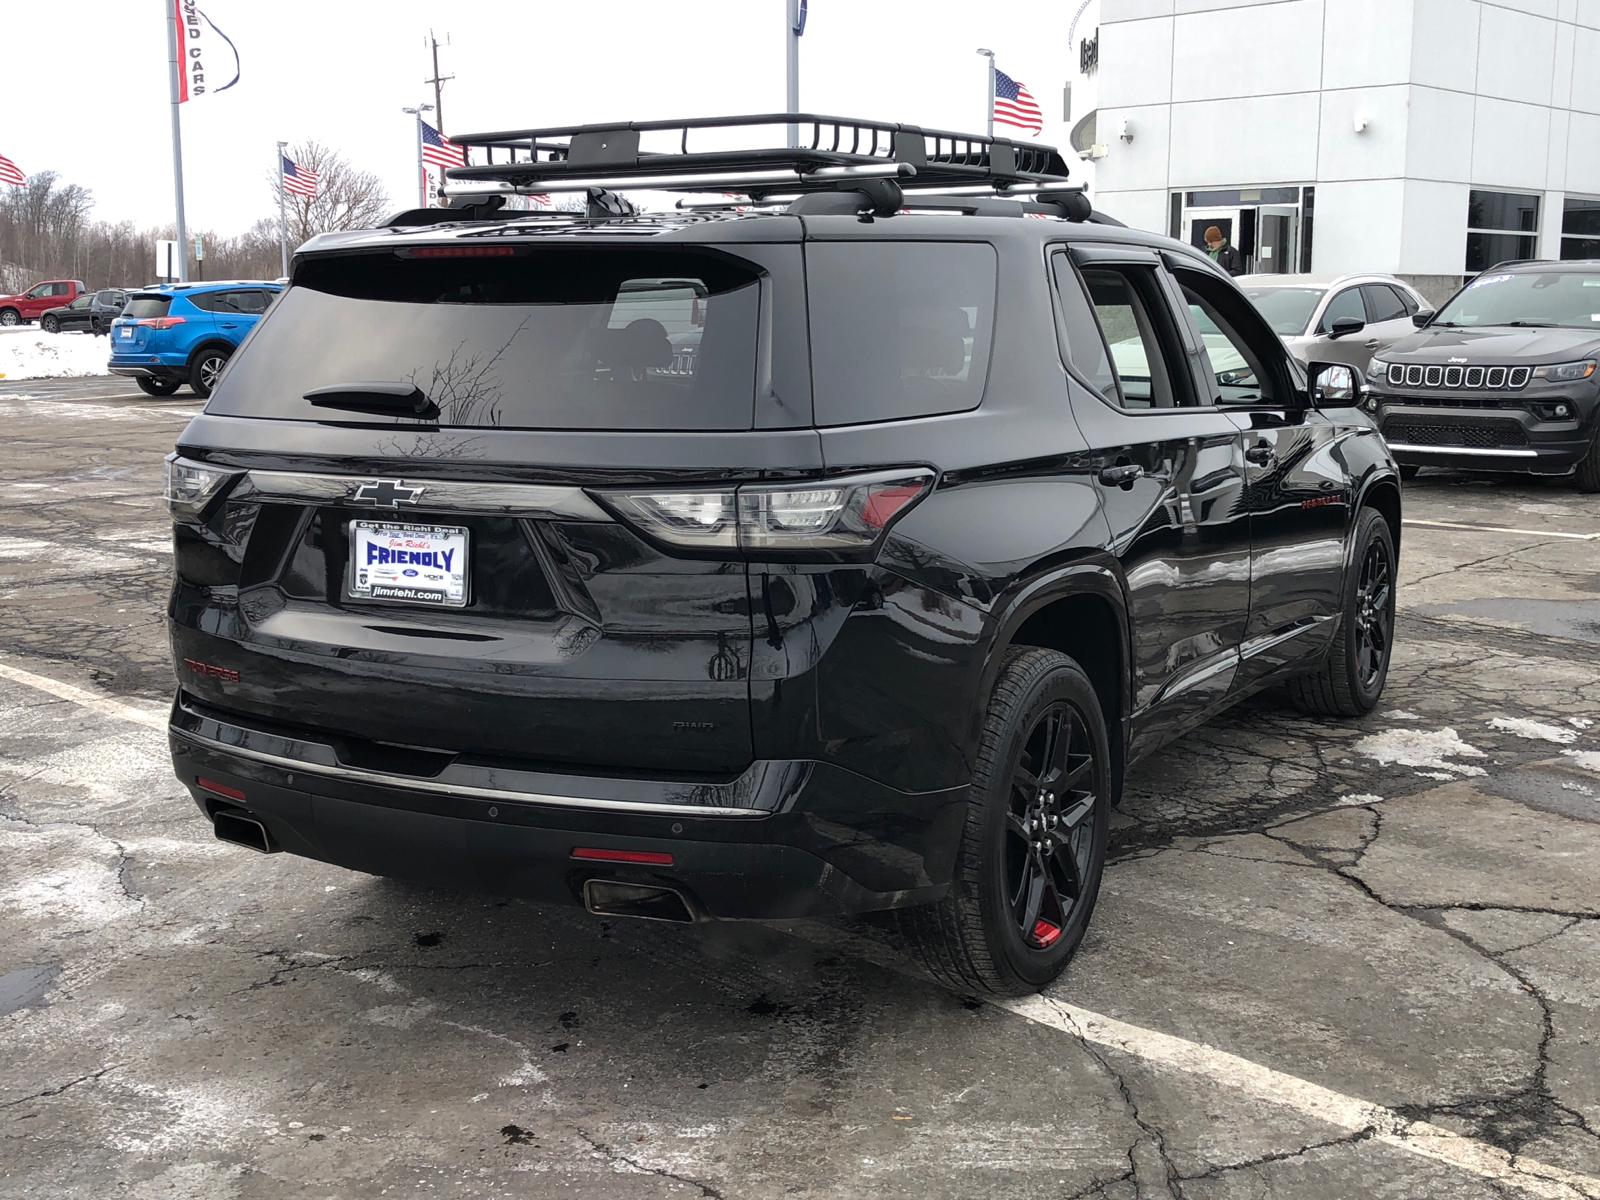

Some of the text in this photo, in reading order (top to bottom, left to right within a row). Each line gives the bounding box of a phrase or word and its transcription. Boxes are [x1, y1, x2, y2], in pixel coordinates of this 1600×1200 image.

[189, 48, 205, 96] CARS
[1447, 356, 1468, 364] Jeep
[404, 524, 430, 532] Riehl
[388, 539, 431, 550] Jim Riehl's
[366, 540, 455, 573] FRIENDLY
[372, 586, 442, 600] jimriehl.com
